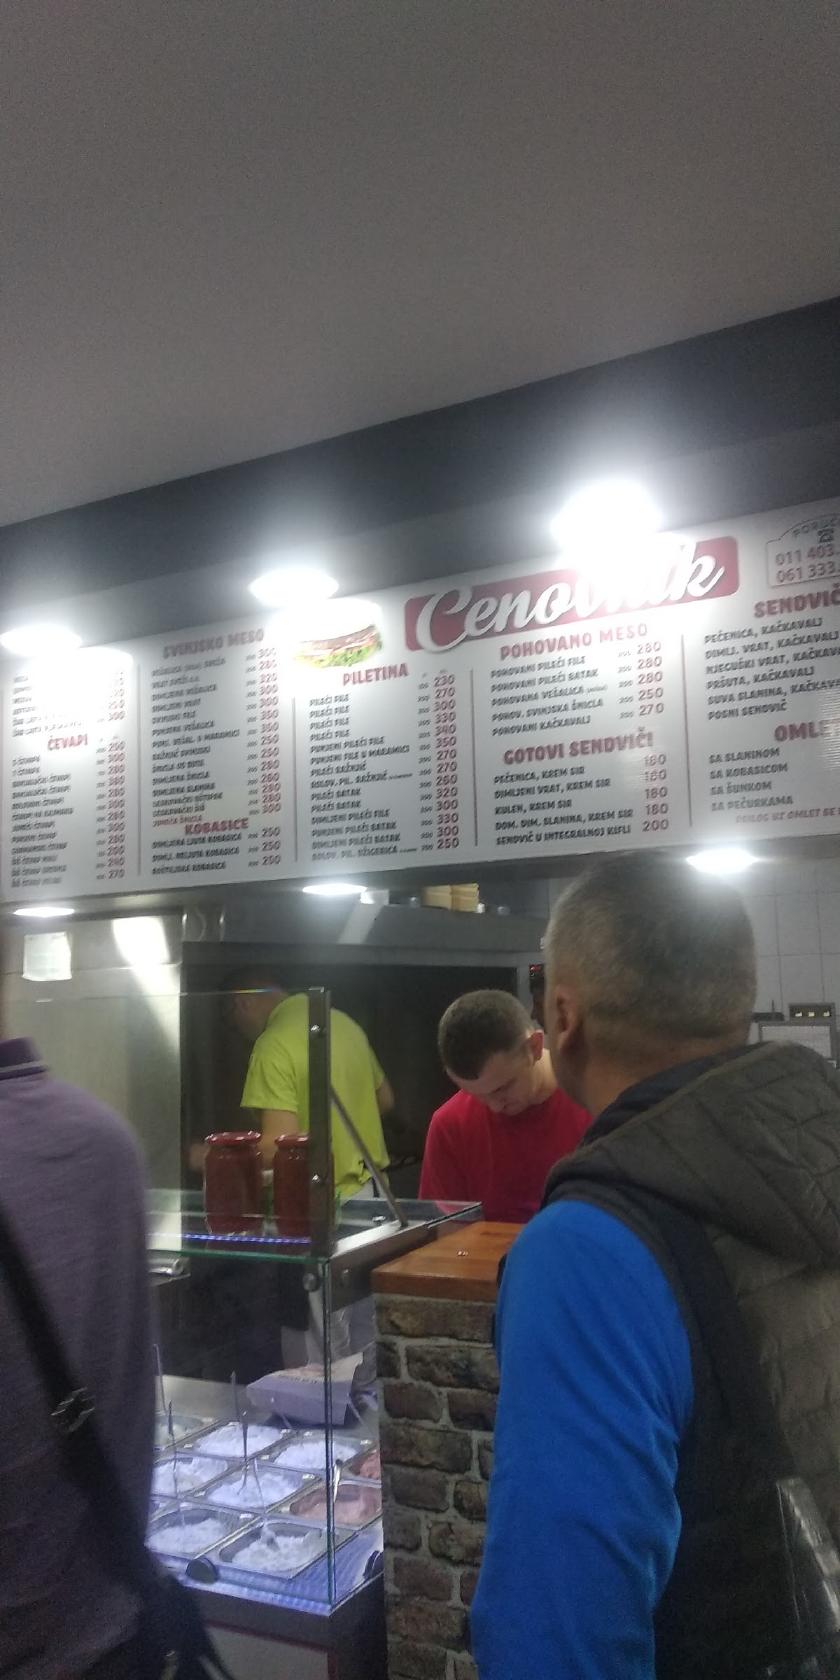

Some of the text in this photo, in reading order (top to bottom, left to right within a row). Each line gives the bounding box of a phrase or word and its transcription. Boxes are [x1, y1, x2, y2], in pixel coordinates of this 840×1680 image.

[776, 550, 802, 566] 011
[776, 567, 802, 583] 061
[761, 617, 823, 635] KAČKAVALJ
[226, 628, 264, 647] MESO
[500, 623, 648, 661] POHOVANO MESO
[778, 631, 839, 648] KAČKAVALJ
[637, 656, 663, 670] 280
[343, 663, 409, 686] PILETINA
[434, 674, 455, 687] 230
[638, 671, 663, 685] 280
[753, 666, 815, 683] KAČKAVALJ
[435, 688, 456, 699] 270
[638, 687, 664, 701] 250
[708, 694, 735, 705] SUVA
[434, 700, 456, 712] 300
[639, 703, 665, 716] 270
[435, 712, 456, 724] 330
[708, 708, 739, 720] POSNI
[435, 724, 456, 736] 340
[435, 737, 457, 749] 350
[503, 727, 654, 765] GOTOVI SENDVIČI
[436, 749, 457, 761] 270
[709, 747, 780, 764] SA SLANINOM
[436, 762, 458, 774] 270
[541, 767, 568, 779] KREM
[570, 766, 585, 776] SIR
[710, 763, 788, 779] SA KOBASICOM
[566, 780, 593, 791] KREM
[595, 778, 611, 788] SIR
[711, 780, 772, 795] SA ŠUNKOM
[436, 787, 458, 799] 320
[529, 800, 556, 812] KREM
[557, 799, 572, 808] SIR
[645, 786, 668, 799] 180
[437, 799, 458, 812] 300
[712, 796, 794, 811] SA PEČURKAMA
[437, 813, 459, 825] 330
[588, 810, 615, 822] KREM
[618, 809, 633, 818] SIR
[645, 803, 669, 815] 180
[185, 818, 248, 835] KOBASICE
[437, 825, 459, 838] 300
[536, 832, 543, 842] U
[607, 824, 632, 835] KIFLI
[642, 819, 669, 832] 200
[262, 840, 281, 852] 250
[437, 838, 460, 850] 250
